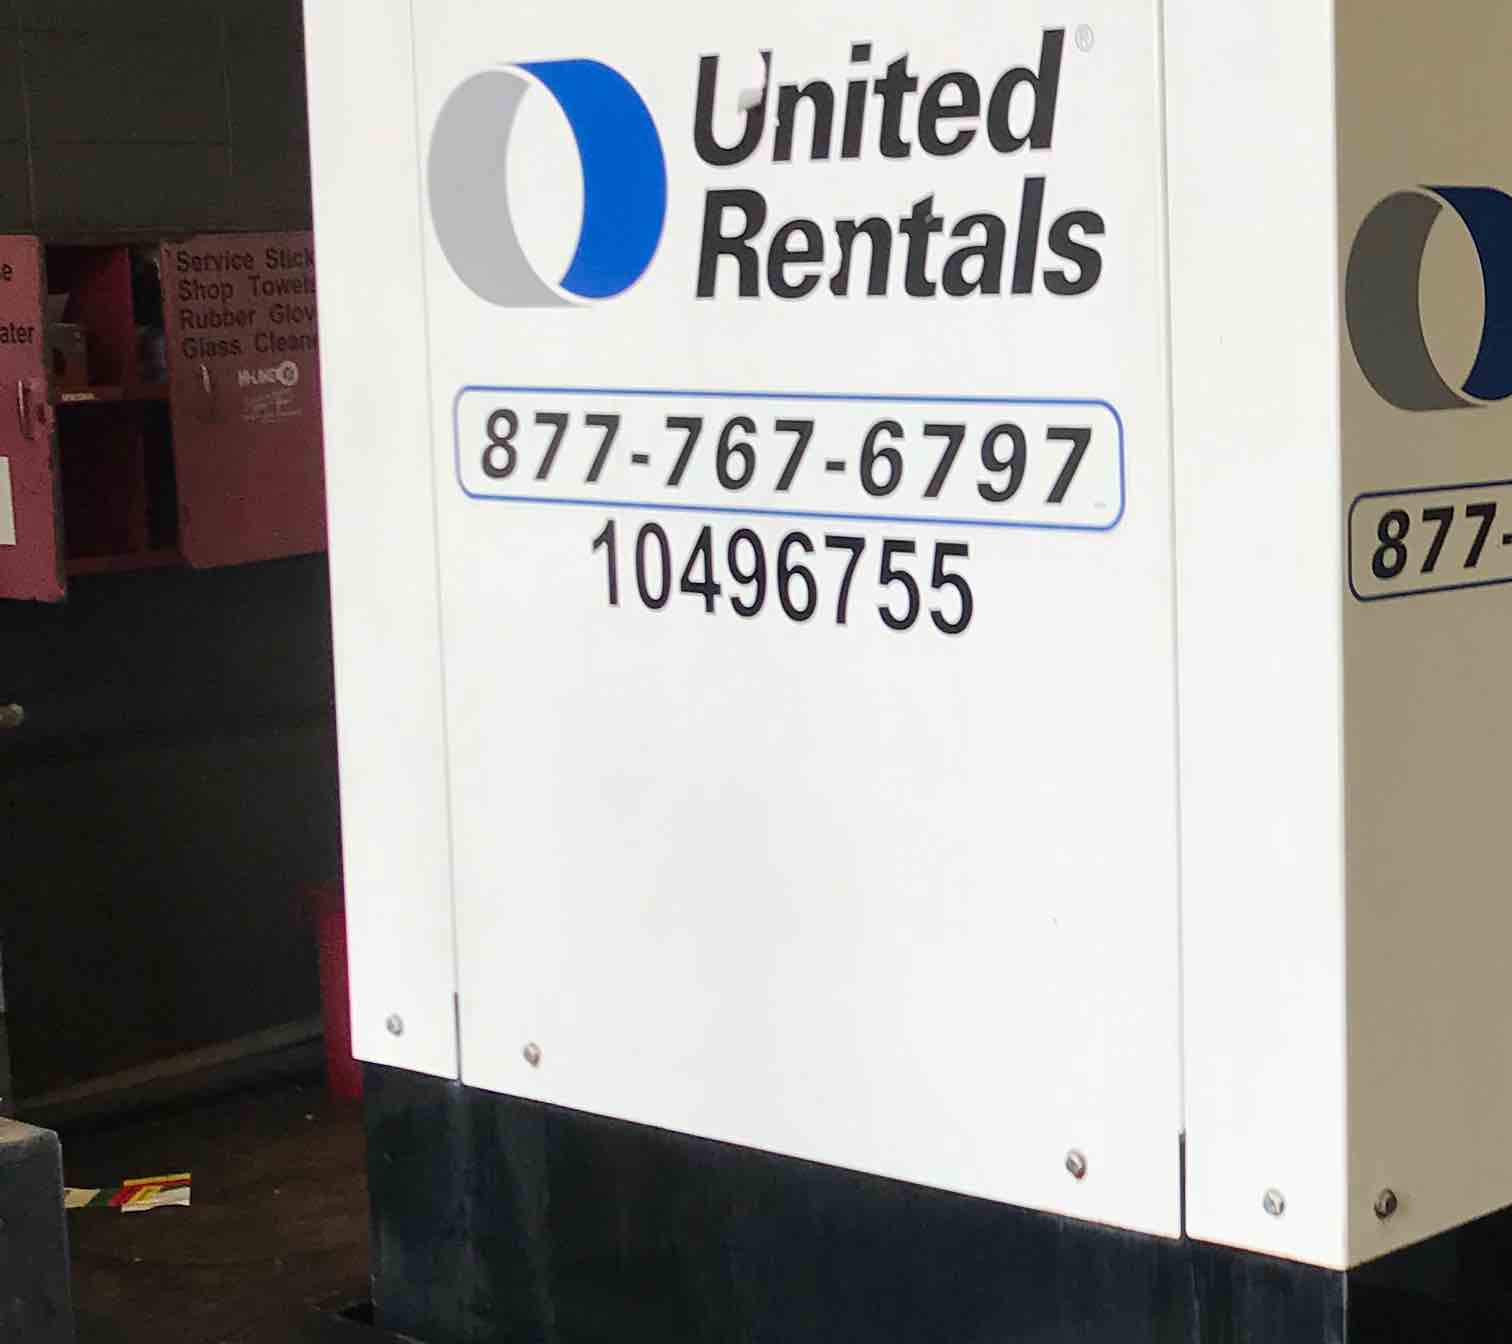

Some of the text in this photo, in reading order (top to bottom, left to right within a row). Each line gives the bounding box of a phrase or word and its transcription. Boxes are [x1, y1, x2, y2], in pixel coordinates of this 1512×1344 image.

[693, 27, 1065, 166] United
[176, 250, 254, 272] Service
[695, 176, 1105, 299] Rentals
[179, 278, 233, 304] Shop
[180, 308, 256, 329] Rubber
[183, 332, 318, 359] Glass Clean
[481, 408, 1093, 504] 877-767-6797
[591, 519, 975, 635] 10496755
